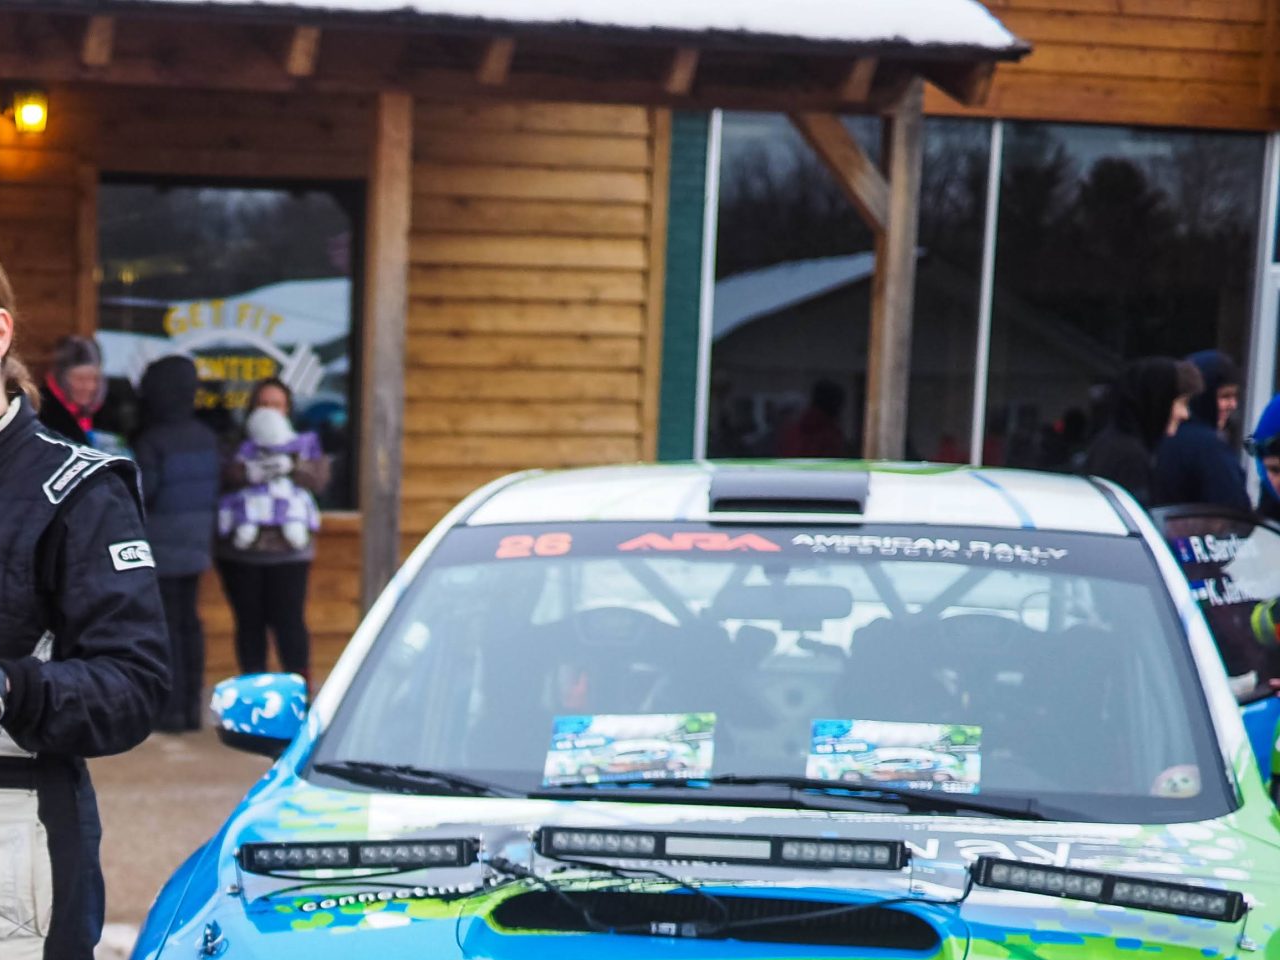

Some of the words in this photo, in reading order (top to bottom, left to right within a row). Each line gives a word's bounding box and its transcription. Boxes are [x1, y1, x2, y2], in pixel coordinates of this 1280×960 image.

[162, 298, 225, 336] GET
[237, 303, 285, 337] FIT
[495, 532, 572, 559] 26
[617, 532, 782, 552] ARA
[792, 533, 960, 552] AMERICAN
[969, 539, 1068, 560] RALLY
